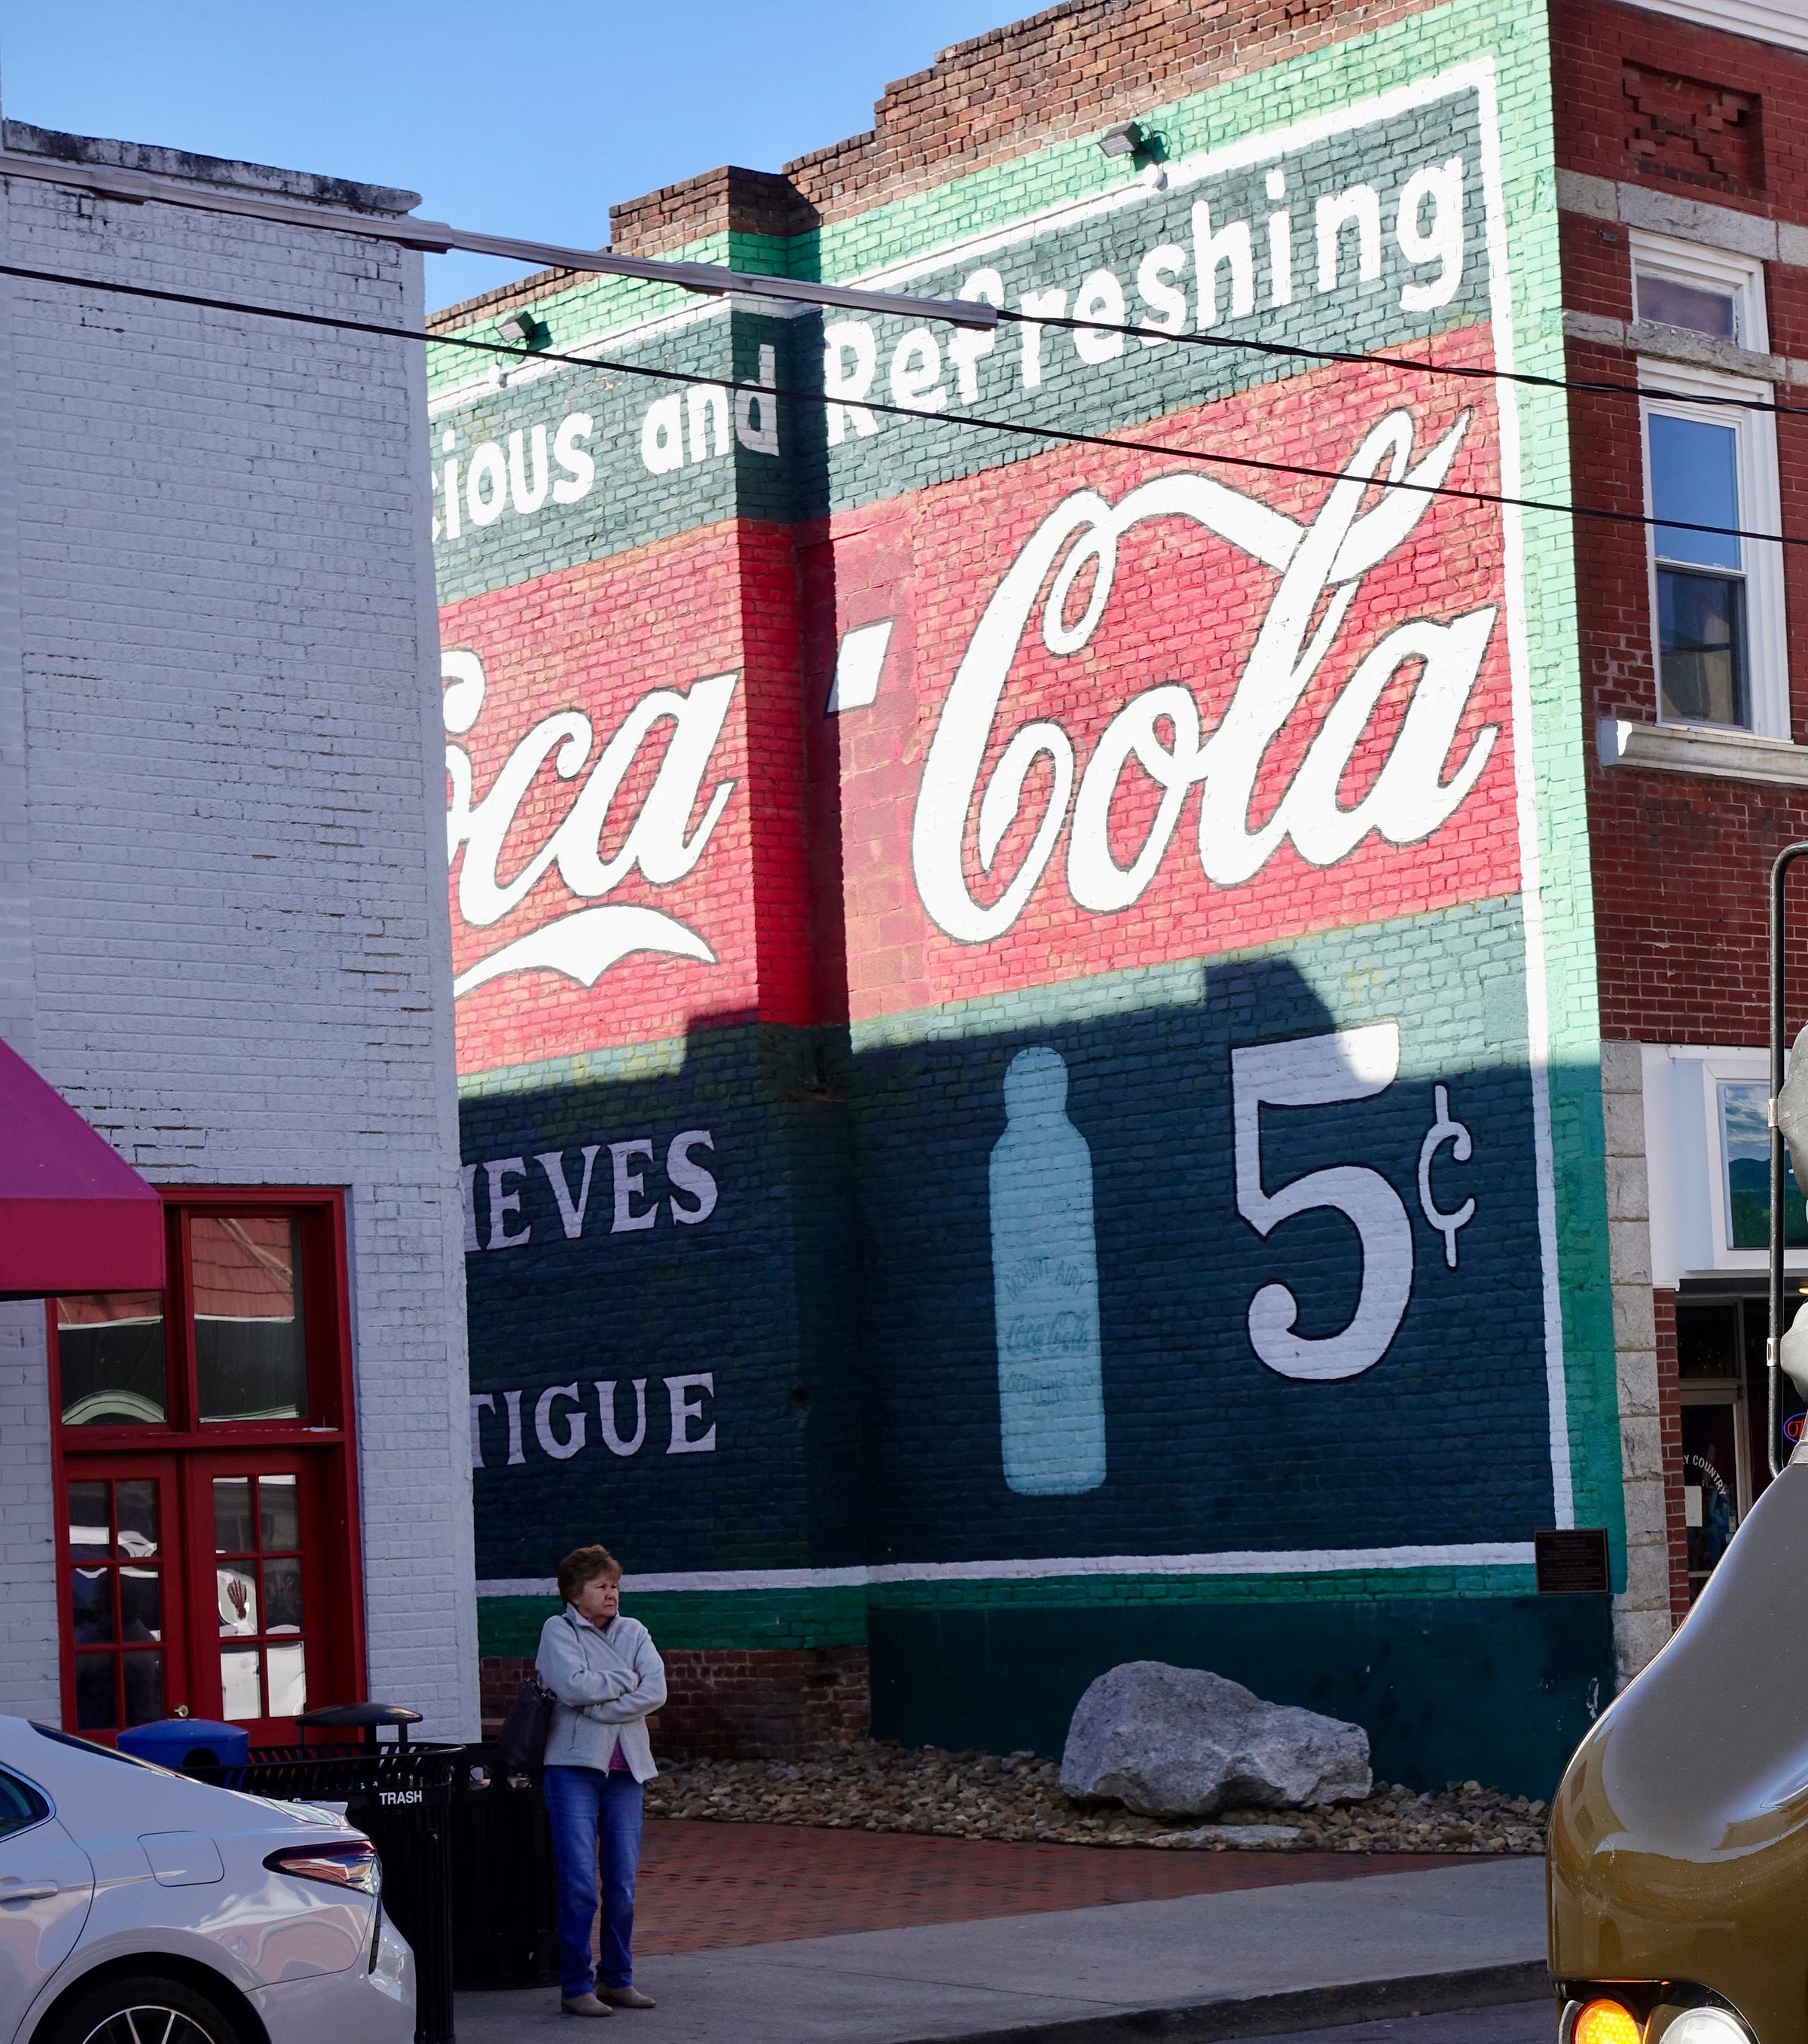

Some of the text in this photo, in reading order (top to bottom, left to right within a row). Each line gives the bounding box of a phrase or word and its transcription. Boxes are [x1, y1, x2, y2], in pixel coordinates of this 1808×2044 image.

[432, 154, 1464, 541] ious and Refreshing
[1693, 1454, 1727, 1495] COUNTRY
[379, 1790, 423, 1805] TRASH
